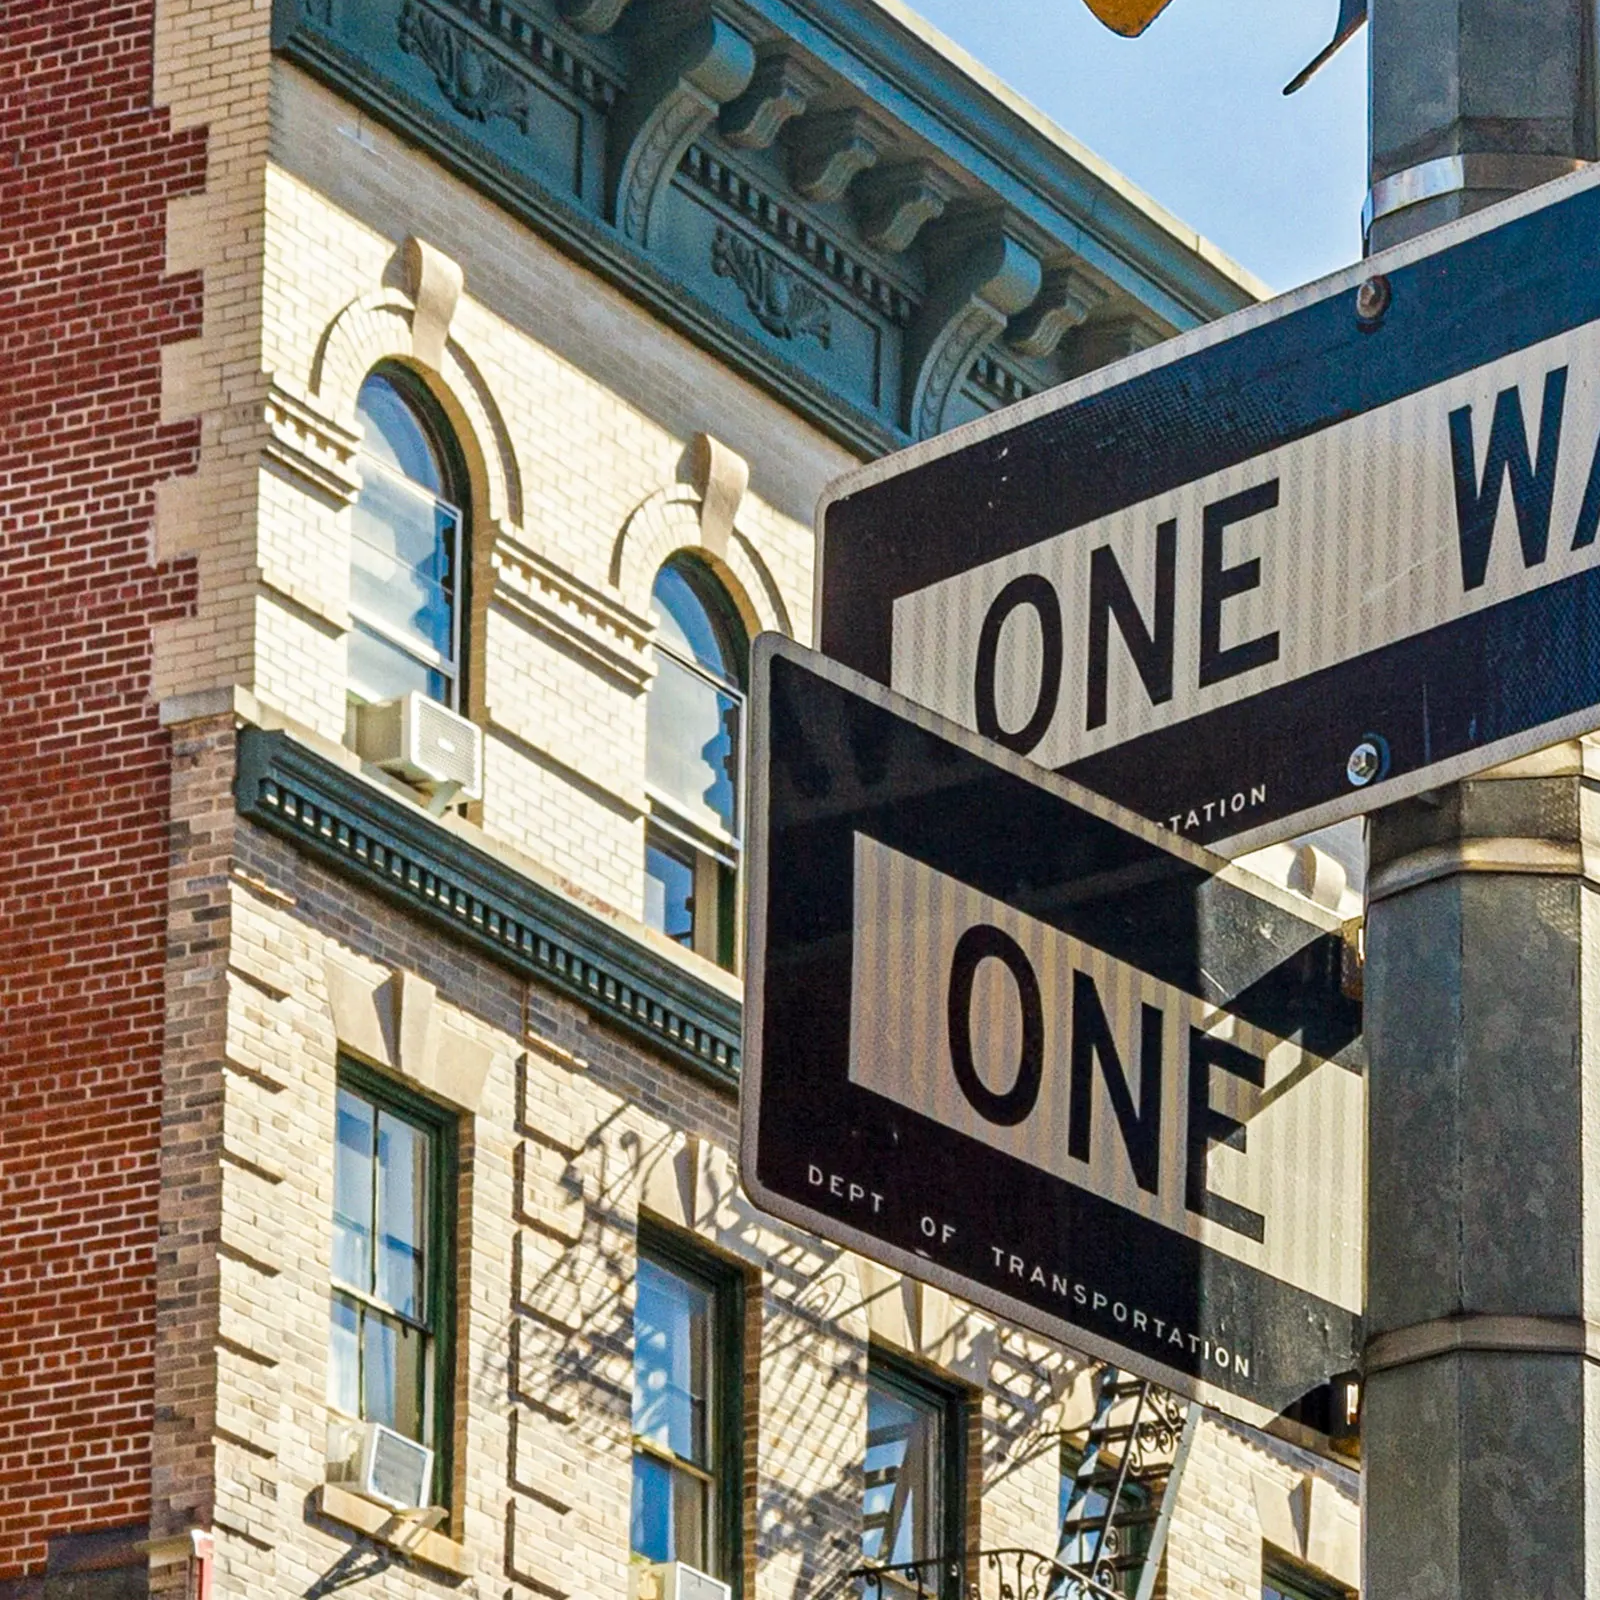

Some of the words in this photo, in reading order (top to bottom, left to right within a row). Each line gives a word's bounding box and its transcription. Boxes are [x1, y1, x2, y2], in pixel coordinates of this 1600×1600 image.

[974, 478, 1280, 758] ONE
[1157, 784, 1266, 834] TATION
[946, 923, 1266, 1244] ONE
[808, 1164, 884, 1213] DEPT
[920, 1216, 956, 1244] OF
[991, 1246, 1250, 1378] TRANSPORTATION
